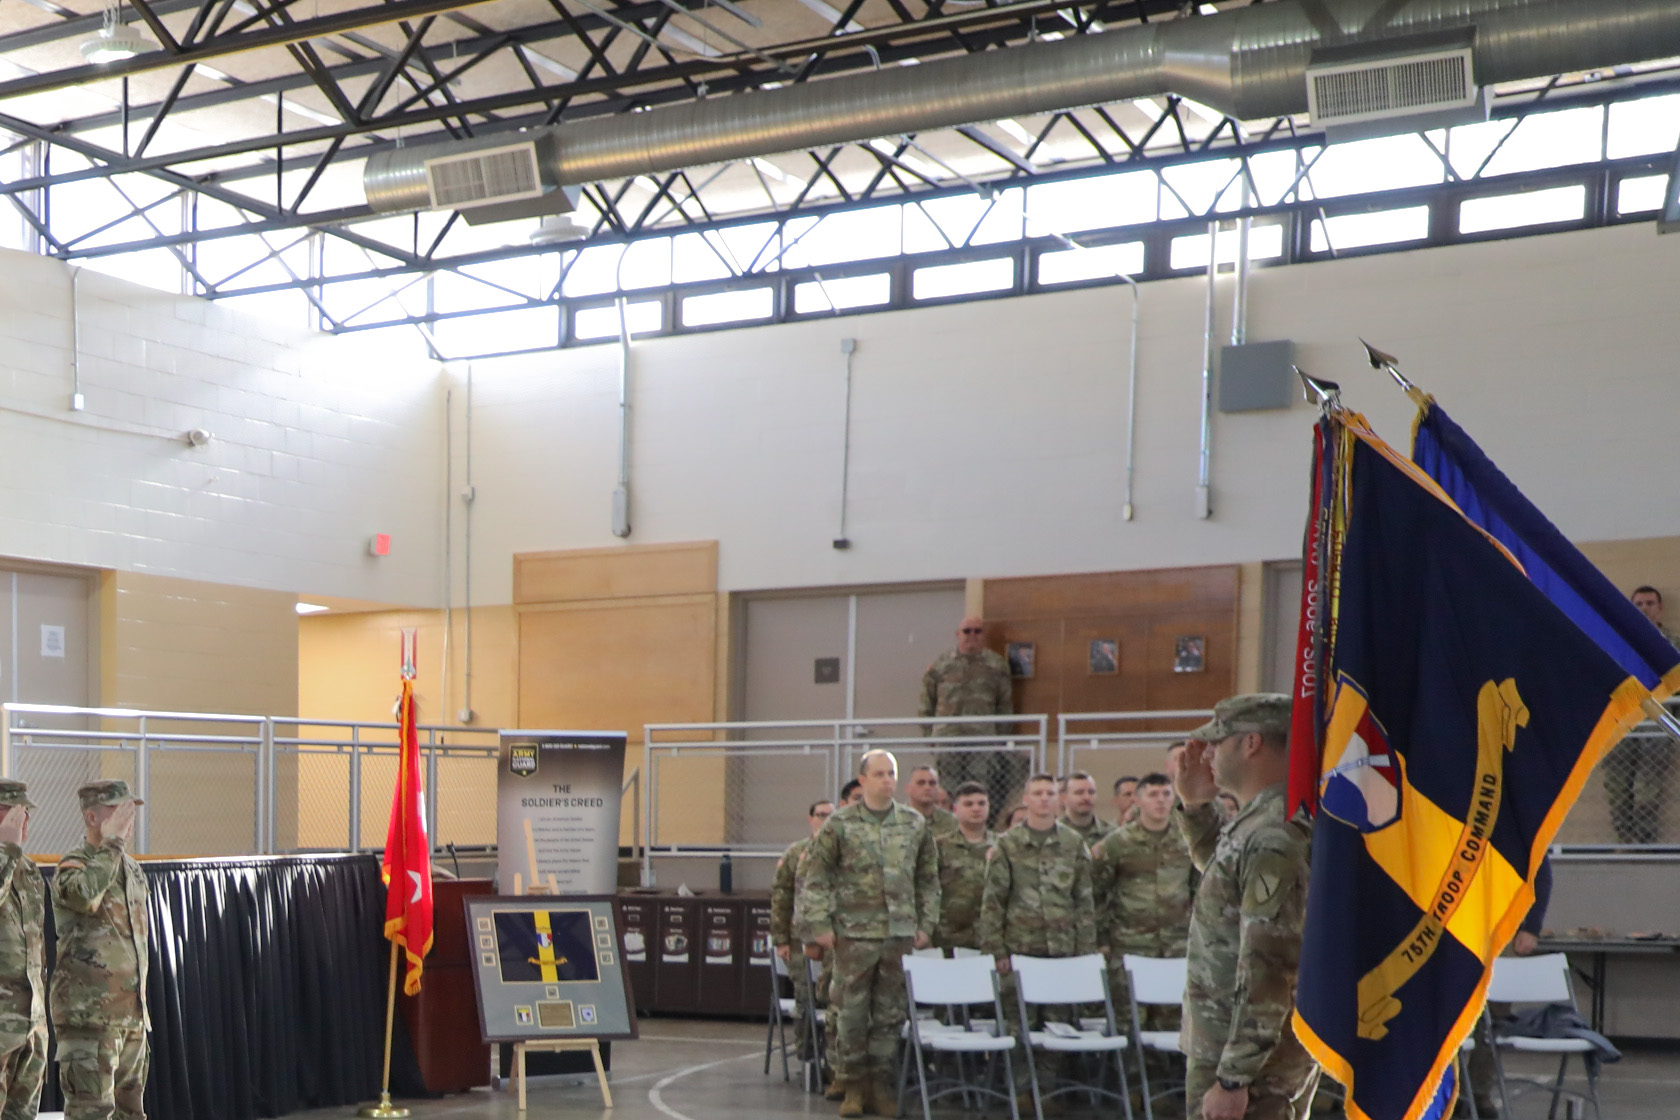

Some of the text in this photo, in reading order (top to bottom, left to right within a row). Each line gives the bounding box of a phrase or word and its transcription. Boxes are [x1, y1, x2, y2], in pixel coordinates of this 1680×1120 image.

[553, 784, 571, 793] THE
[521, 798, 603, 807] SOLDIER'S CREED
[1401, 773, 1497, 963] 75TH TROOP COMMAND
